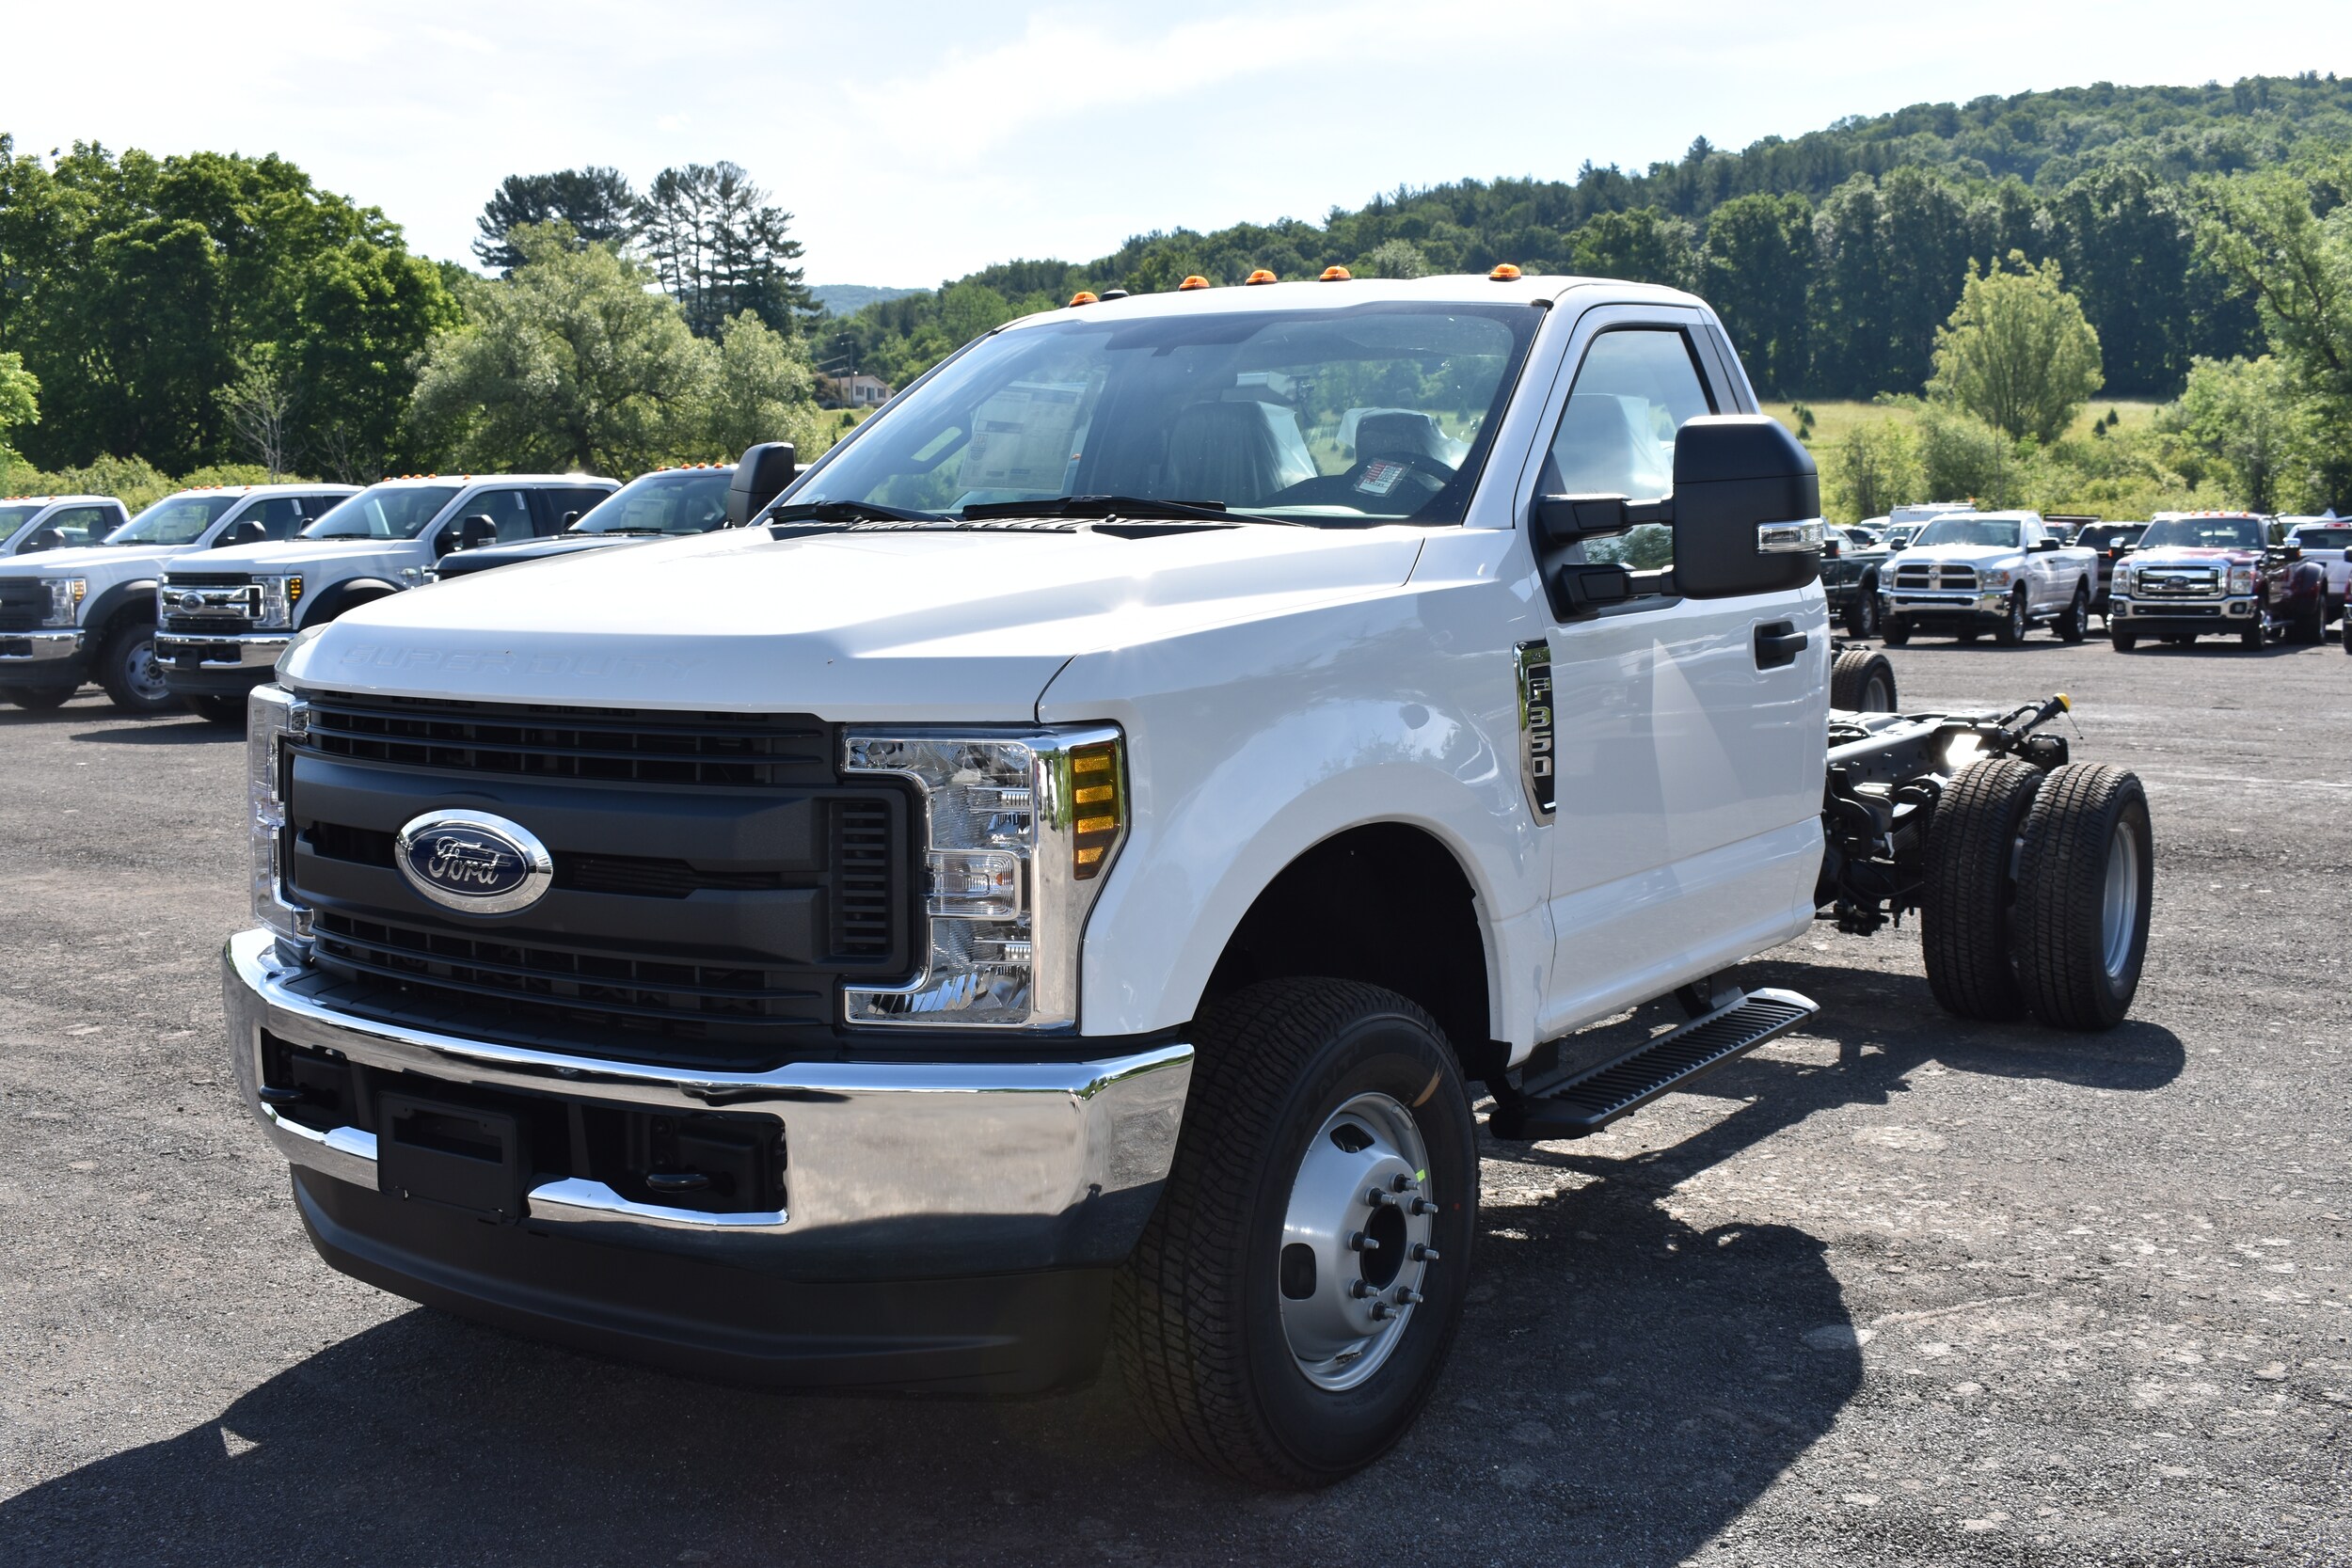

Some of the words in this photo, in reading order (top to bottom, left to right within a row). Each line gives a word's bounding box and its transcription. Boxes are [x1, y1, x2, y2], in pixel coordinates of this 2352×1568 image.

[341, 644, 518, 675] SUPER
[524, 653, 713, 680] DUTY
[428, 836, 499, 885] Ford
